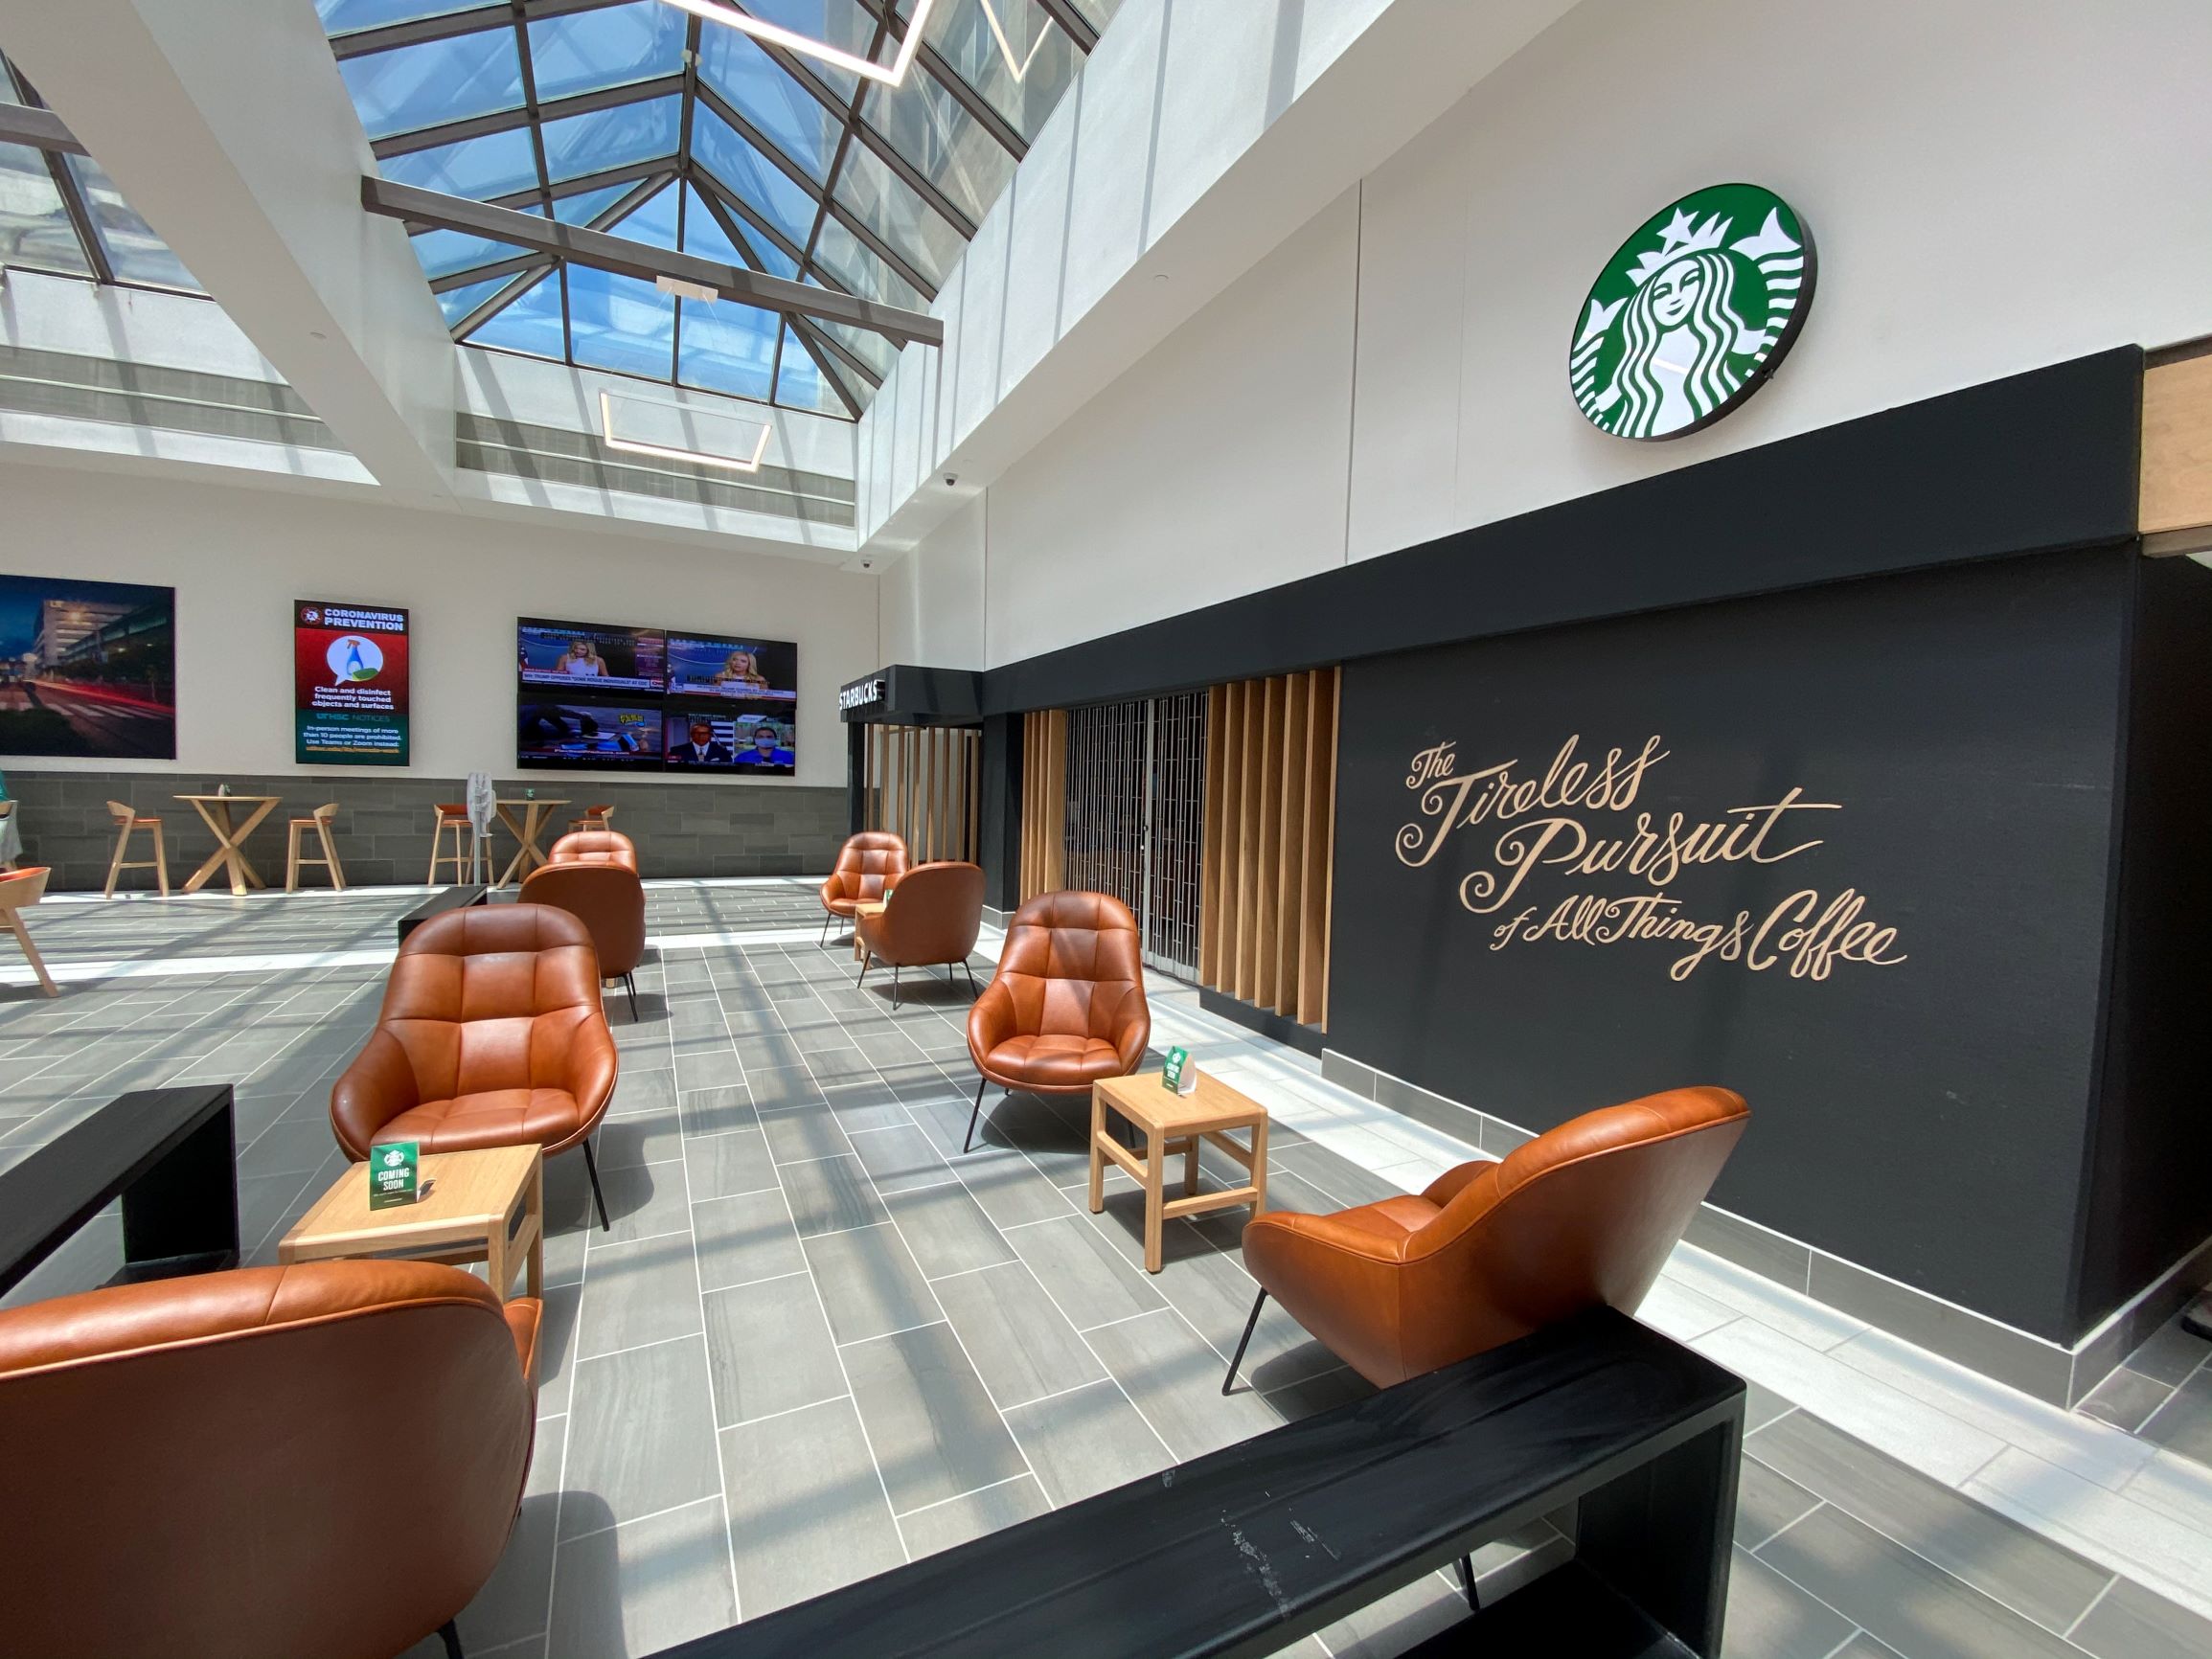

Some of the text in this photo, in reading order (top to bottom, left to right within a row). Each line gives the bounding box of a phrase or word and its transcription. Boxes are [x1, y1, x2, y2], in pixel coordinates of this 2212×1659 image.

[324, 608, 403, 623] CORONAVIRUS
[324, 617, 403, 631] PREVENTION
[314, 693, 356, 702] frequently
[356, 688, 391, 696] disinfect
[839, 679, 878, 710] STARBUCKS
[1405, 740, 1457, 791] The
[1395, 734, 1671, 867] Tireless
[1459, 786, 1843, 914] Pursuit
[1489, 887, 1908, 982] of All Things Coffee
[377, 1167, 410, 1182] COMING
[383, 1178, 404, 1191] SOON
